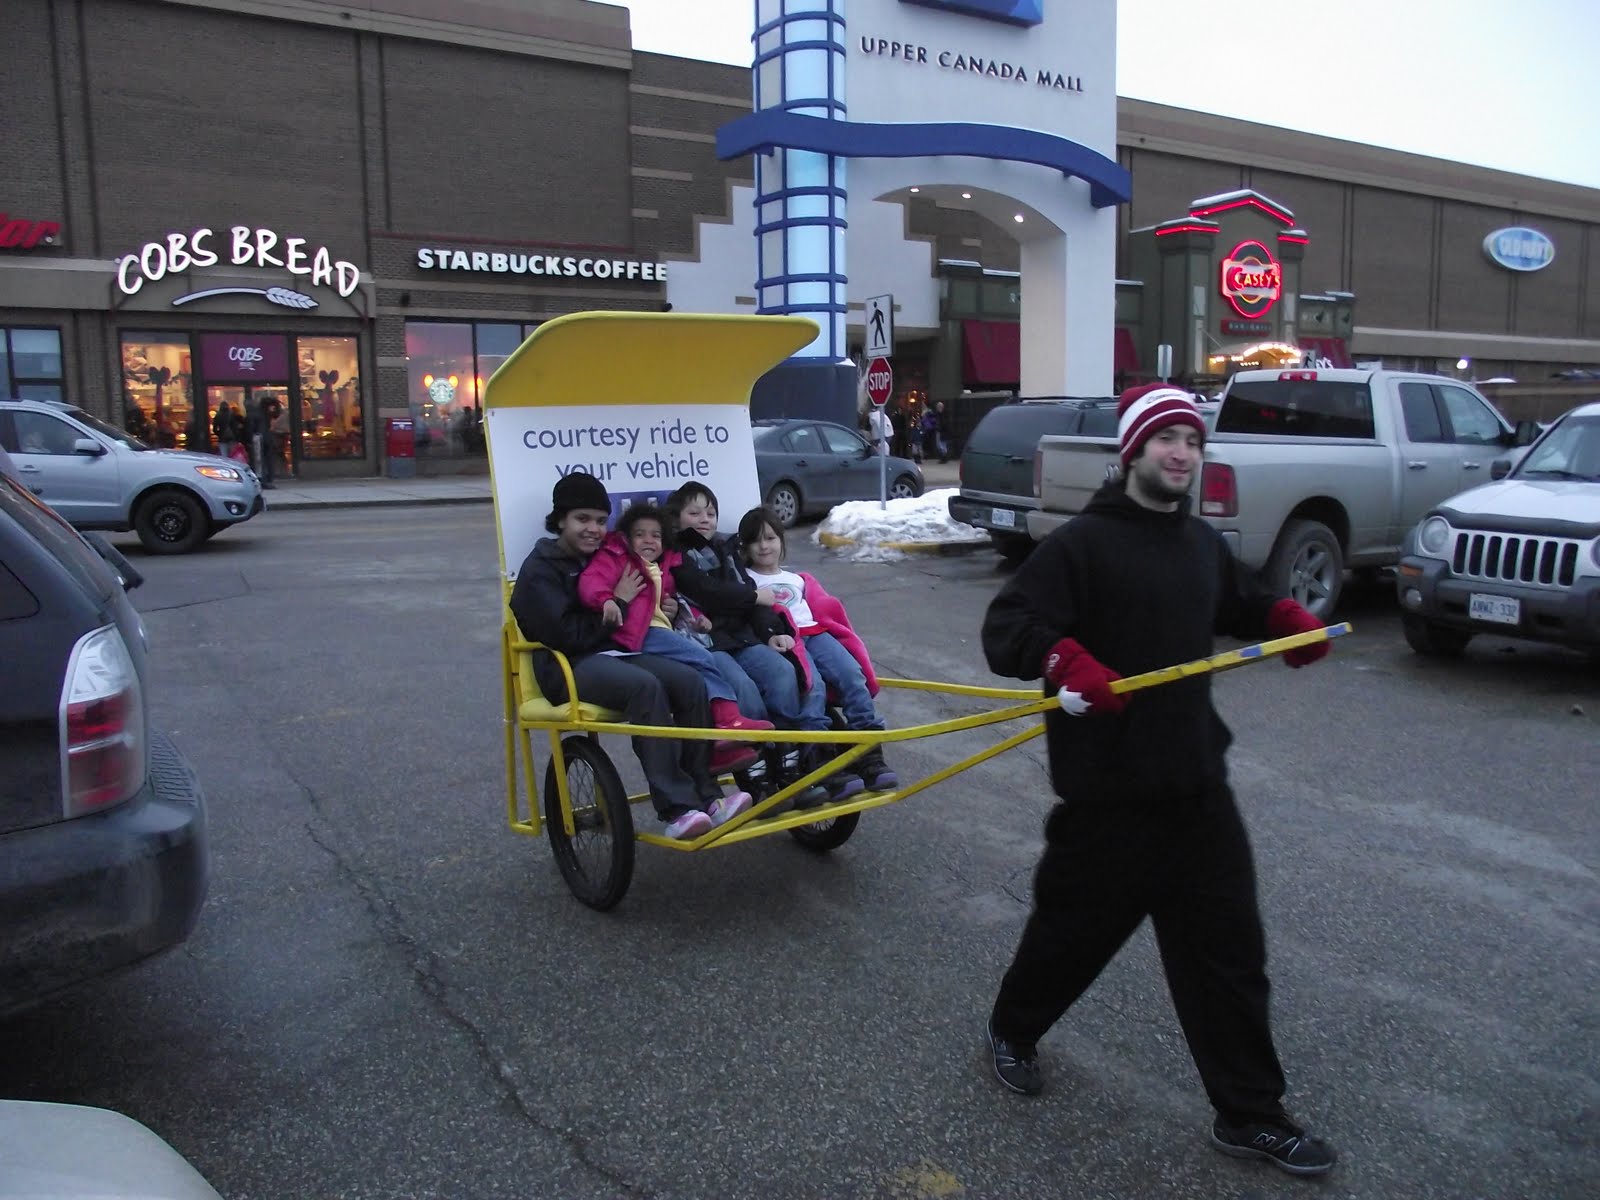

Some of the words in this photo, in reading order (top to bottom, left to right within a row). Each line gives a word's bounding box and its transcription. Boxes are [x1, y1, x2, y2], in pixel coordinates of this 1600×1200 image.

[861, 35, 928, 64] UPPER
[938, 51, 1028, 82] CANADA
[1036, 70, 1084, 92] MALL
[117, 228, 219, 295] COBS
[230, 225, 361, 298] BREAD
[229, 346, 264, 362] COBS
[869, 372, 889, 390] STOP
[523, 426, 641, 454] courtesy
[650, 418, 697, 445] ride
[705, 423, 729, 444] to
[625, 451, 710, 480] vehicle
